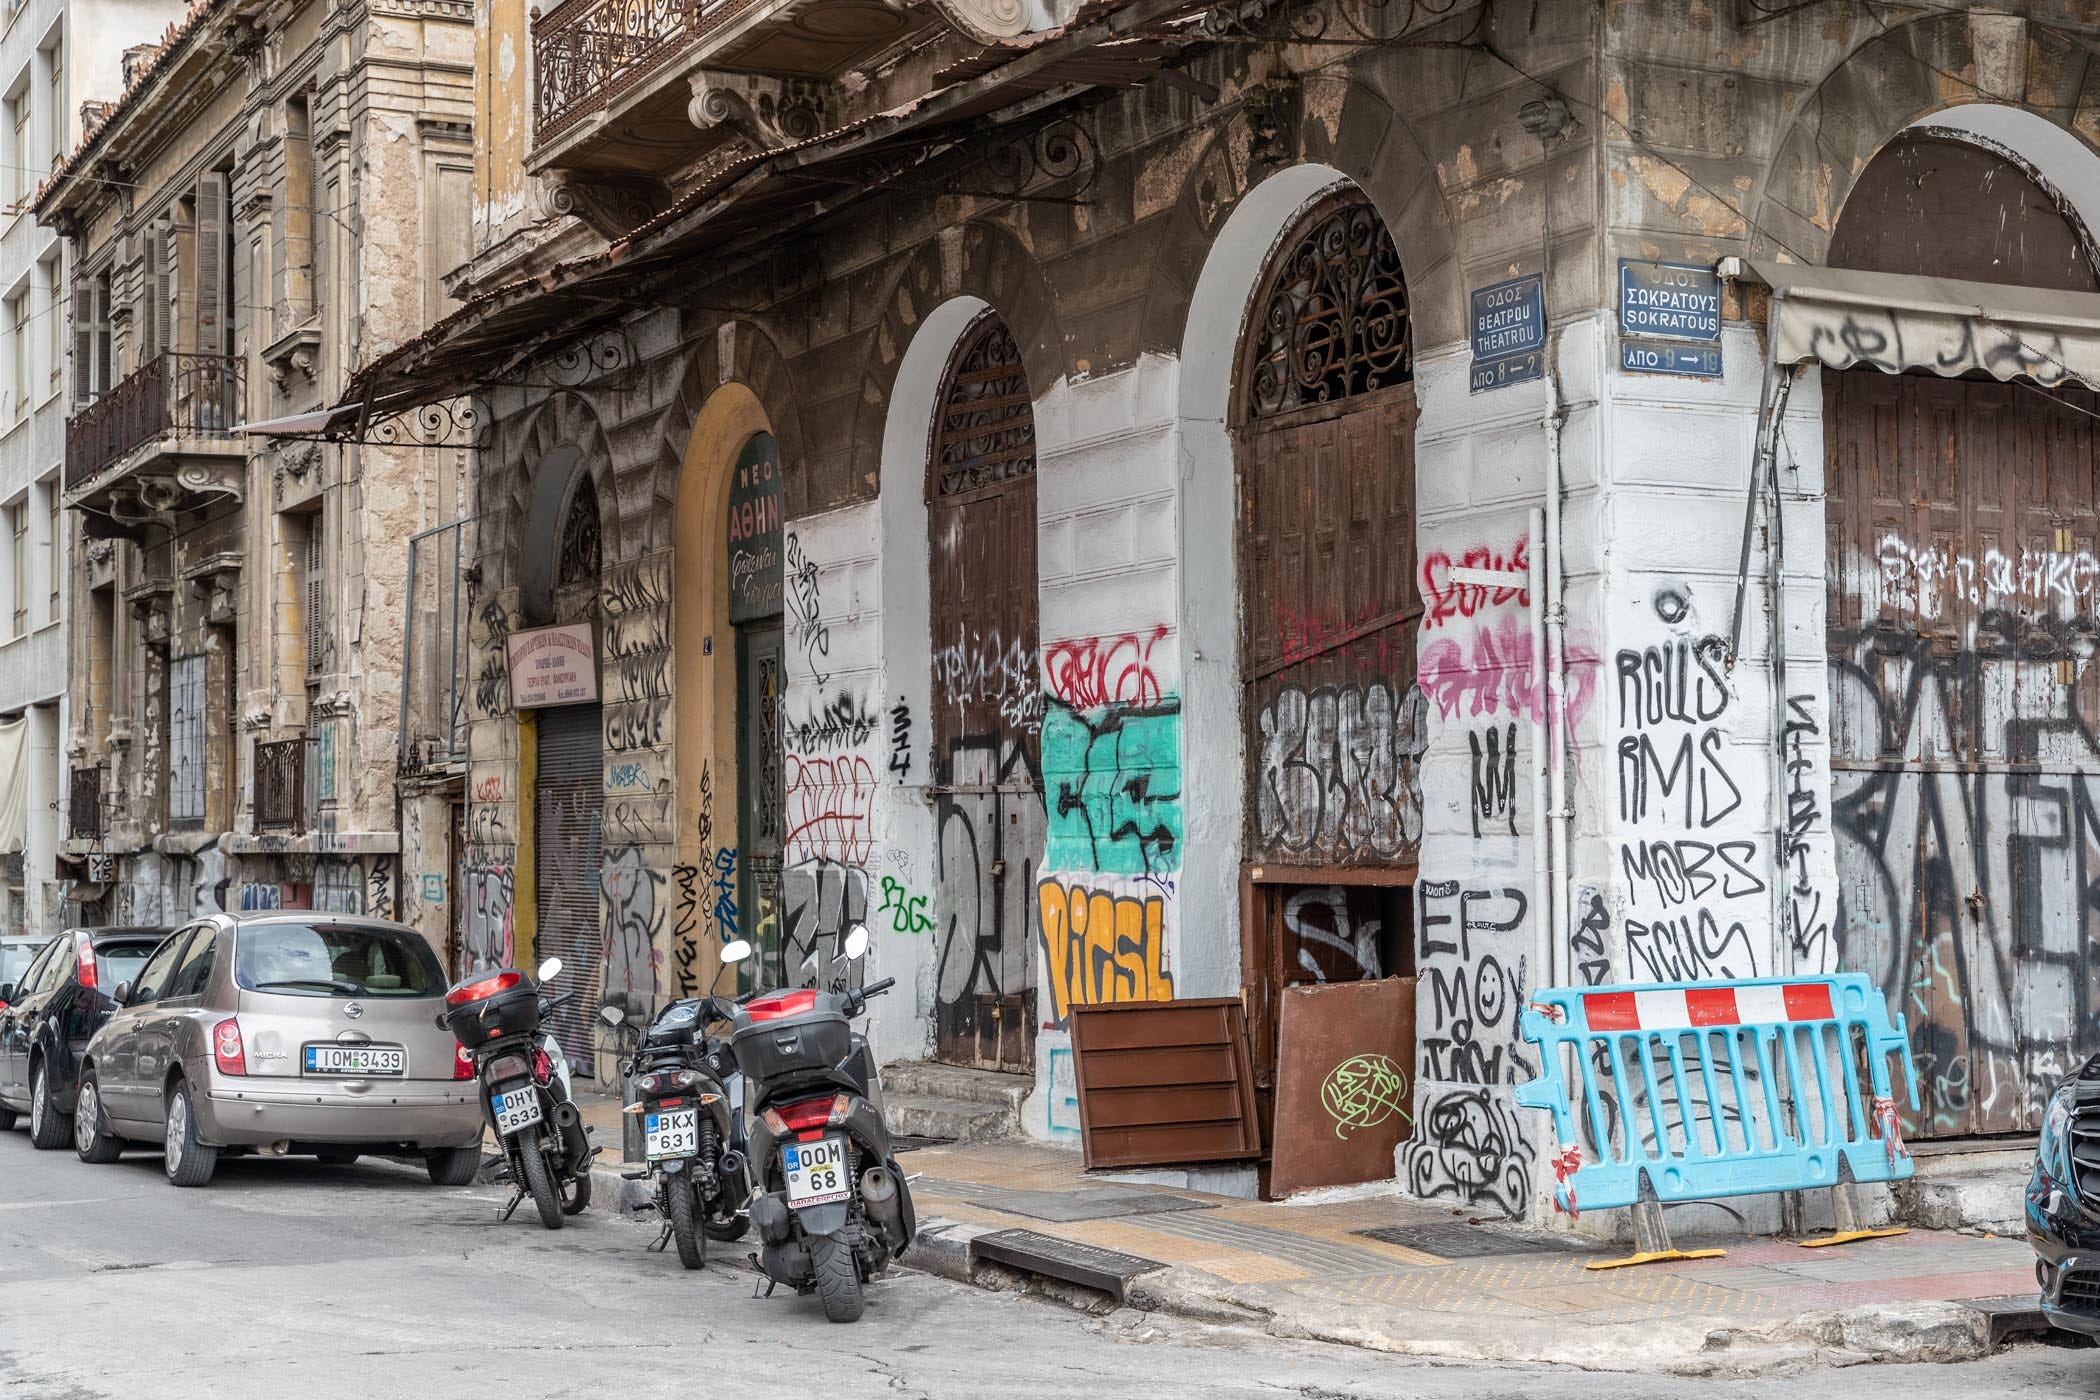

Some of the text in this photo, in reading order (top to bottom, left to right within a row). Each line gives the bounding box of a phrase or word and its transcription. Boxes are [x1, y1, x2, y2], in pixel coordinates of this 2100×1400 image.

[1487, 287, 1522, 308] ΟΔΟΣ
[1627, 288, 1717, 312] ΣΩΚΡΑΤΟΥΣ
[1627, 310, 1717, 332] SOKRATOUS
[1478, 325, 1534, 353] THEATROU
[1627, 350, 1658, 367] ΑΠΟ
[1472, 370, 1494, 389] ΑΠΟ
[1498, 362, 1505, 381] 8
[730, 494, 785, 543] ΑΘΗΝ
[254, 1052, 288, 1060] MICRA
[504, 1089, 533, 1110] OHY
[509, 1106, 539, 1126] 633
[660, 1113, 694, 1131] BKX
[660, 1132, 694, 1149] 631
[787, 1161, 799, 1170] GR
[800, 1144, 841, 1168] OOM
[810, 1170, 837, 1191] 68
